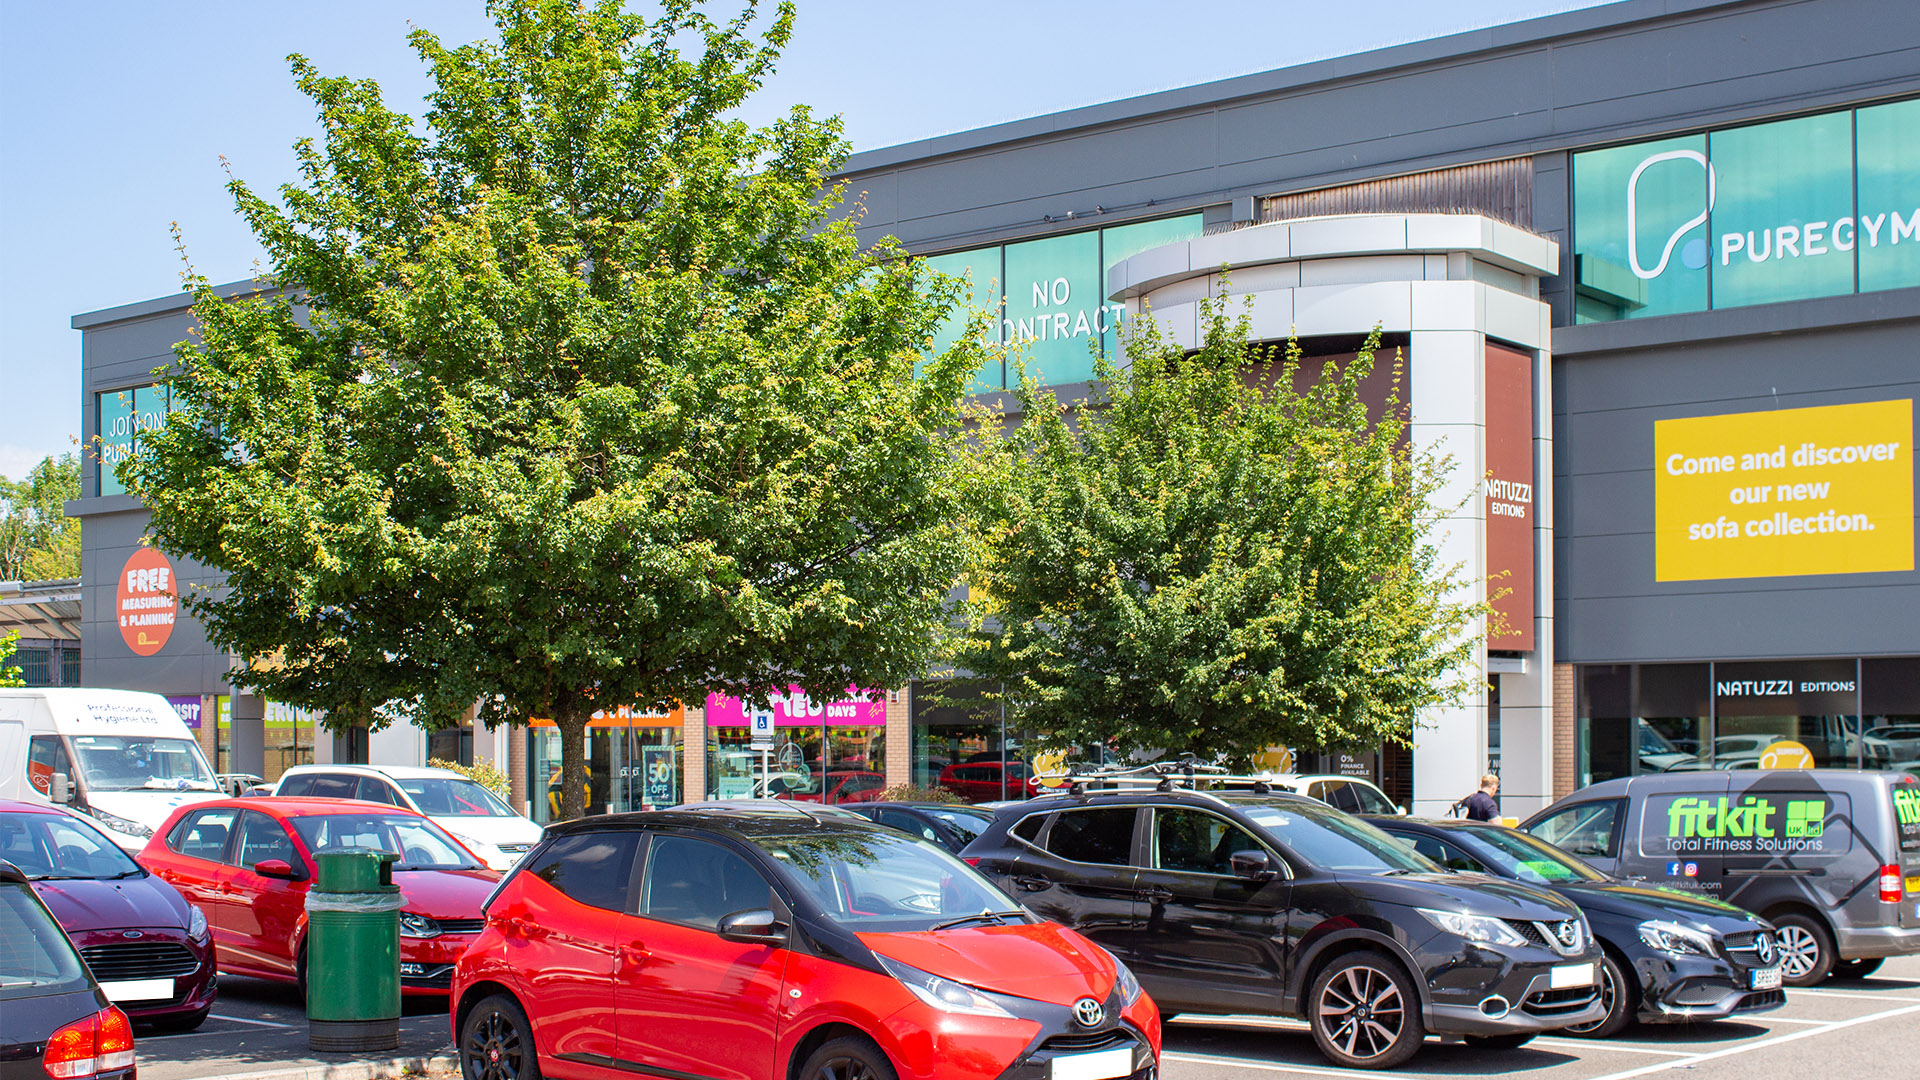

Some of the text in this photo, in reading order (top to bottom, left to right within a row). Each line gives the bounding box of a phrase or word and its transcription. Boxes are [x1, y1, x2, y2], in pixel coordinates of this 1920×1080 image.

[1721, 208, 1920, 266] PUREGYM
[1032, 277, 1071, 308] NO
[1666, 442, 1899, 476] Come and discover
[1485, 479, 1532, 503] NATUZZI
[1729, 481, 1831, 505] our new
[1491, 501, 1525, 518] EDITIONS
[1688, 509, 1876, 541] sofa collection.
[127, 567, 170, 593] FREE
[122, 596, 173, 610] MEASURING
[120, 613, 174, 627] & PLANNING
[1716, 680, 1856, 697] NATUZZI EDITIONS
[827, 705, 857, 718] DAYS
[1667, 796, 1776, 838] fitkit
[1788, 826, 1802, 835] UK
[1666, 837, 1823, 851] Total Fitness Solutions
